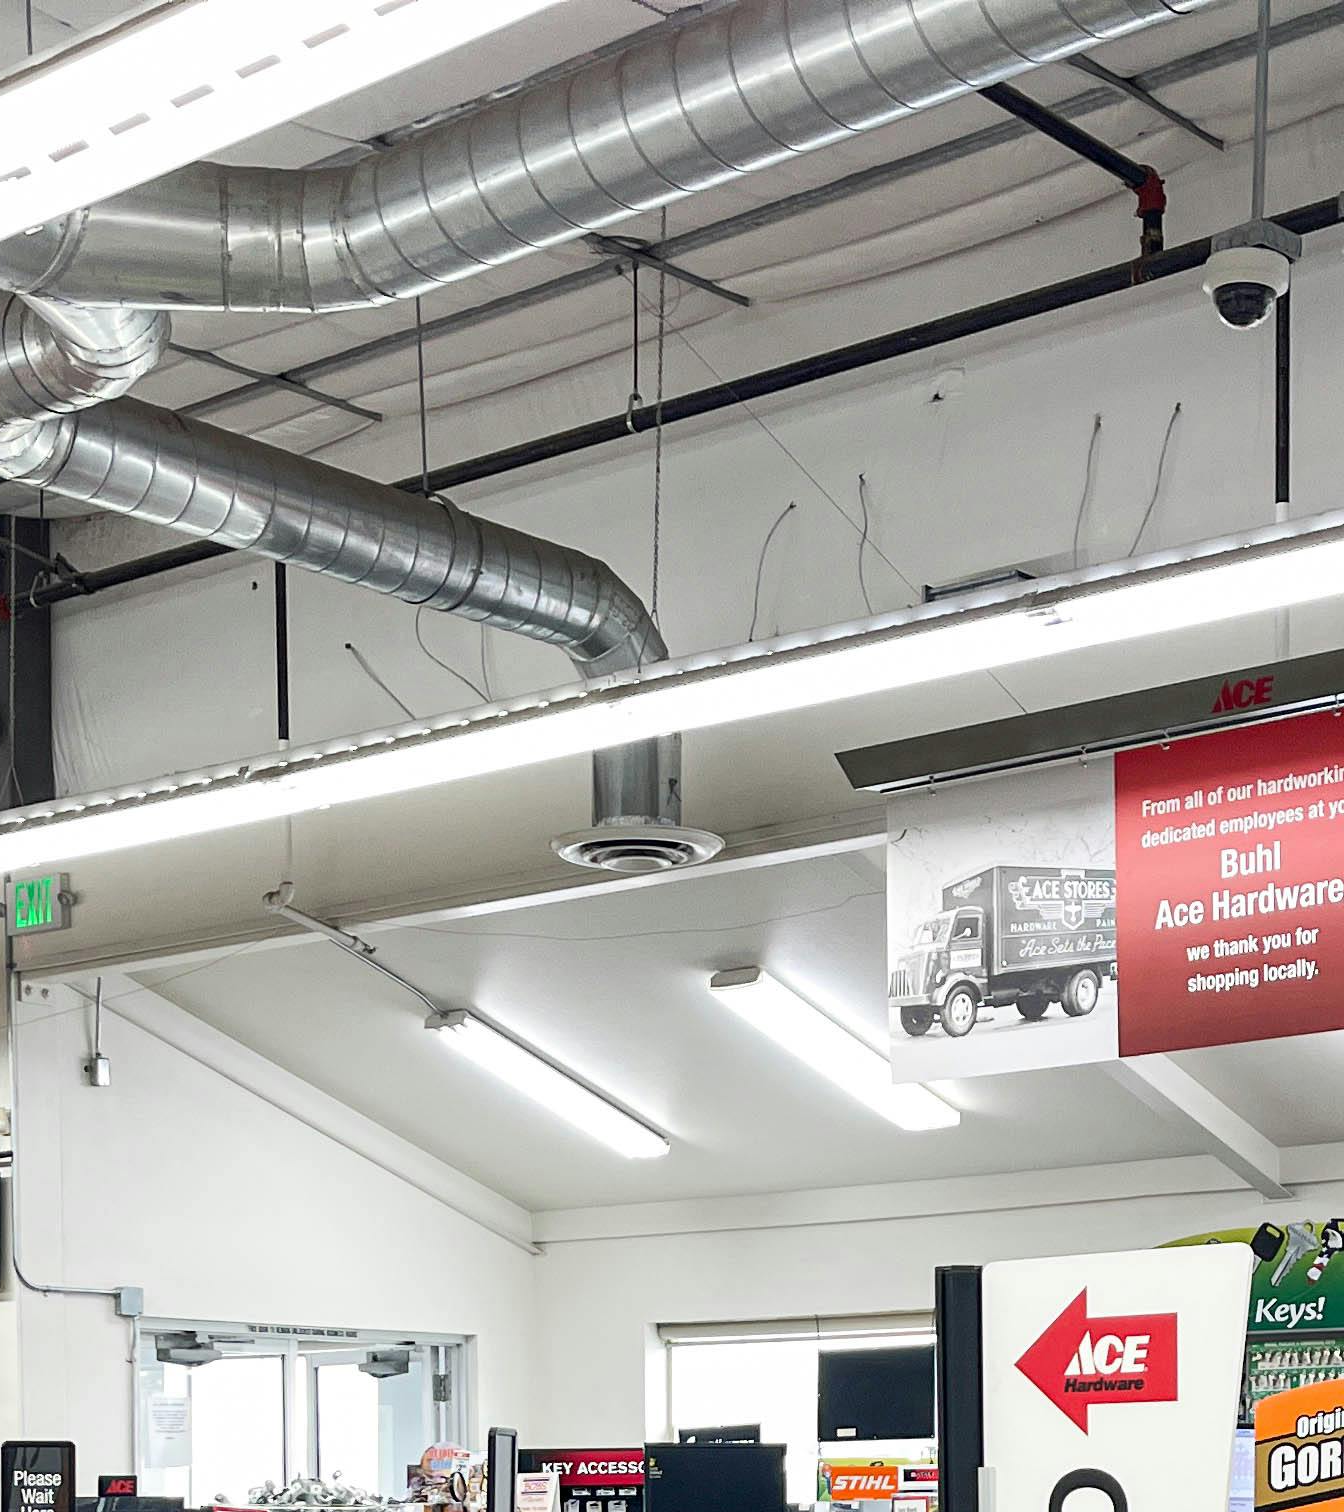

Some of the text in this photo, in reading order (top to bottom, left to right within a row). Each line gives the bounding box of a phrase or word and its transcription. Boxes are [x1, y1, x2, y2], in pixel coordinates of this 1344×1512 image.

[1211, 675, 1275, 713] ACE
[1142, 800, 1180, 817] From
[1185, 791, 1203, 810] all
[1207, 787, 1223, 806] of
[1227, 783, 1253, 801] our
[1141, 819, 1216, 848] dedicated
[1220, 806, 1304, 839] employees
[1308, 800, 1324, 819] at
[1220, 841, 1282, 879] Buhl
[1032, 878, 1110, 899] ACE STORES
[1155, 899, 1204, 930] Ace
[1186, 926, 1320, 962] we thank you for
[1187, 958, 1319, 993] shopping locally.
[1254, 1296, 1326, 1329] Keys!
[1063, 1329, 1150, 1376] ACE
[1064, 1376, 1144, 1394] Hardware
[13, 1470, 62, 1488] Please
[542, 1461, 573, 1476] KEY
[833, 1475, 898, 1491] STIHL
[21, 1488, 55, 1505] Wait
[104, 1479, 134, 1495] ACE
